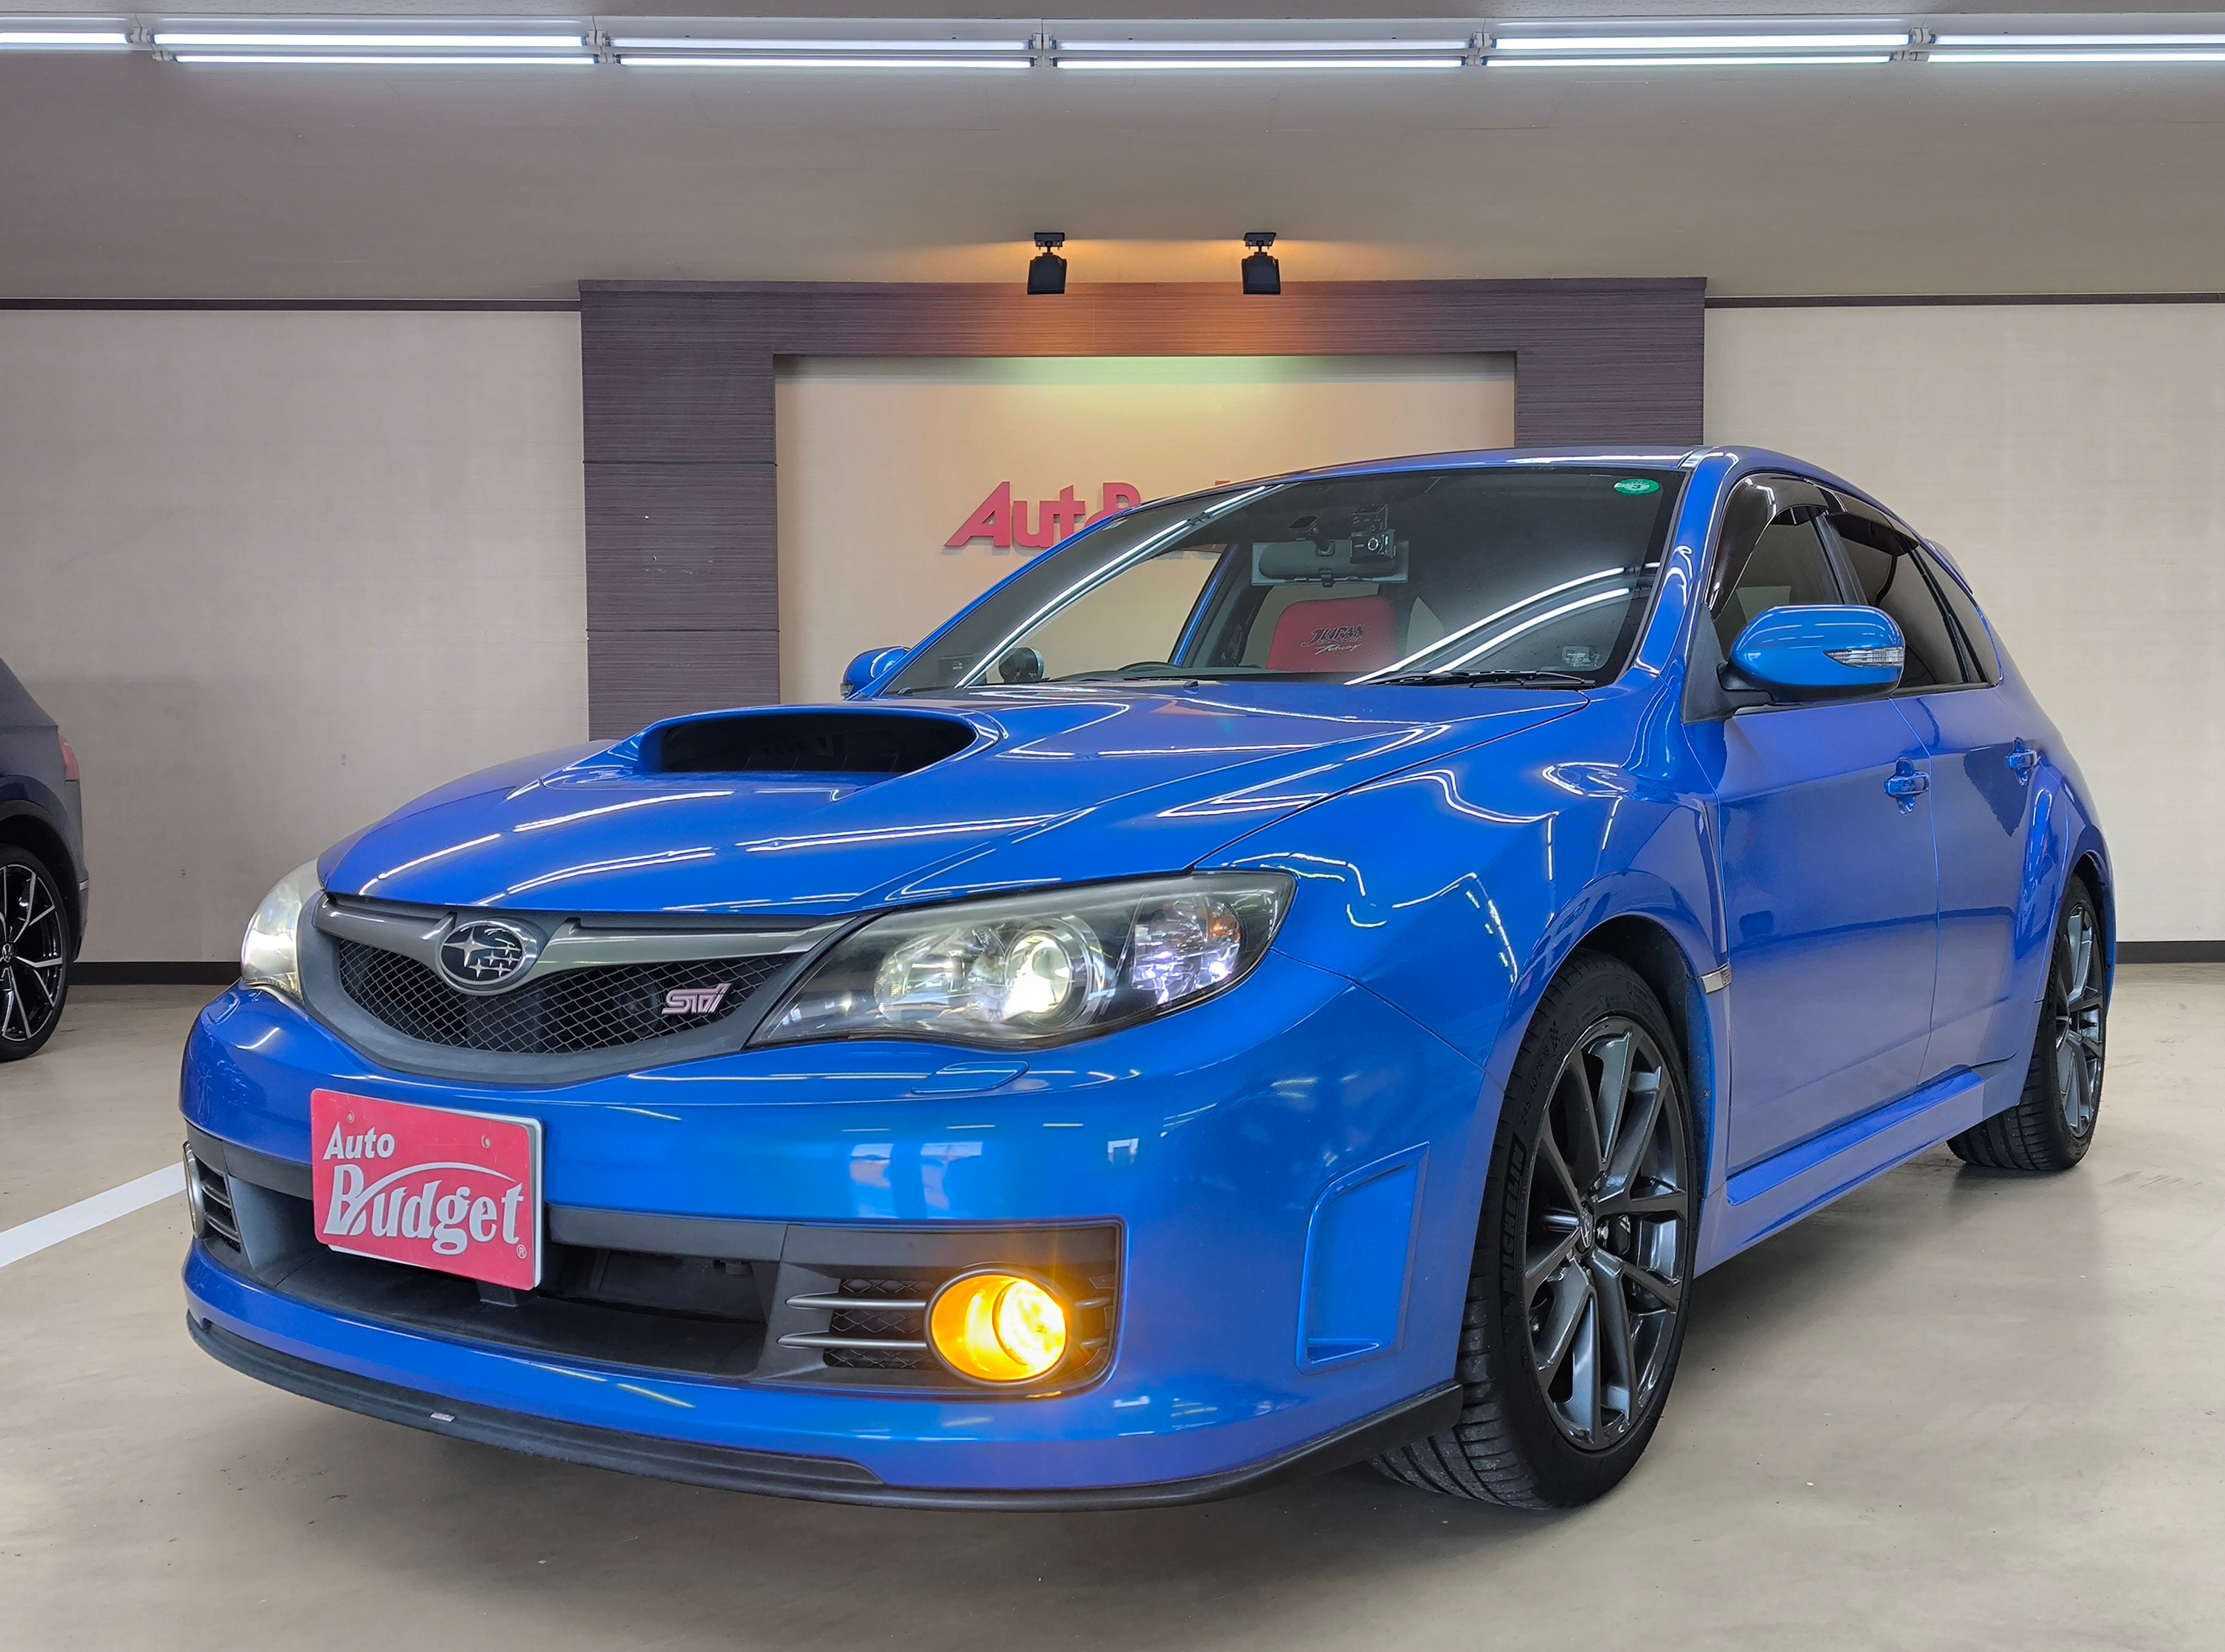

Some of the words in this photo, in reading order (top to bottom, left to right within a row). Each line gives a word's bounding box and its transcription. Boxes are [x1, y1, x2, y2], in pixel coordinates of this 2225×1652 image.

[323, 1121, 395, 1160] Auto
[323, 1162, 524, 1256] Budget
[1502, 1145, 1524, 1294] MICHELIN
